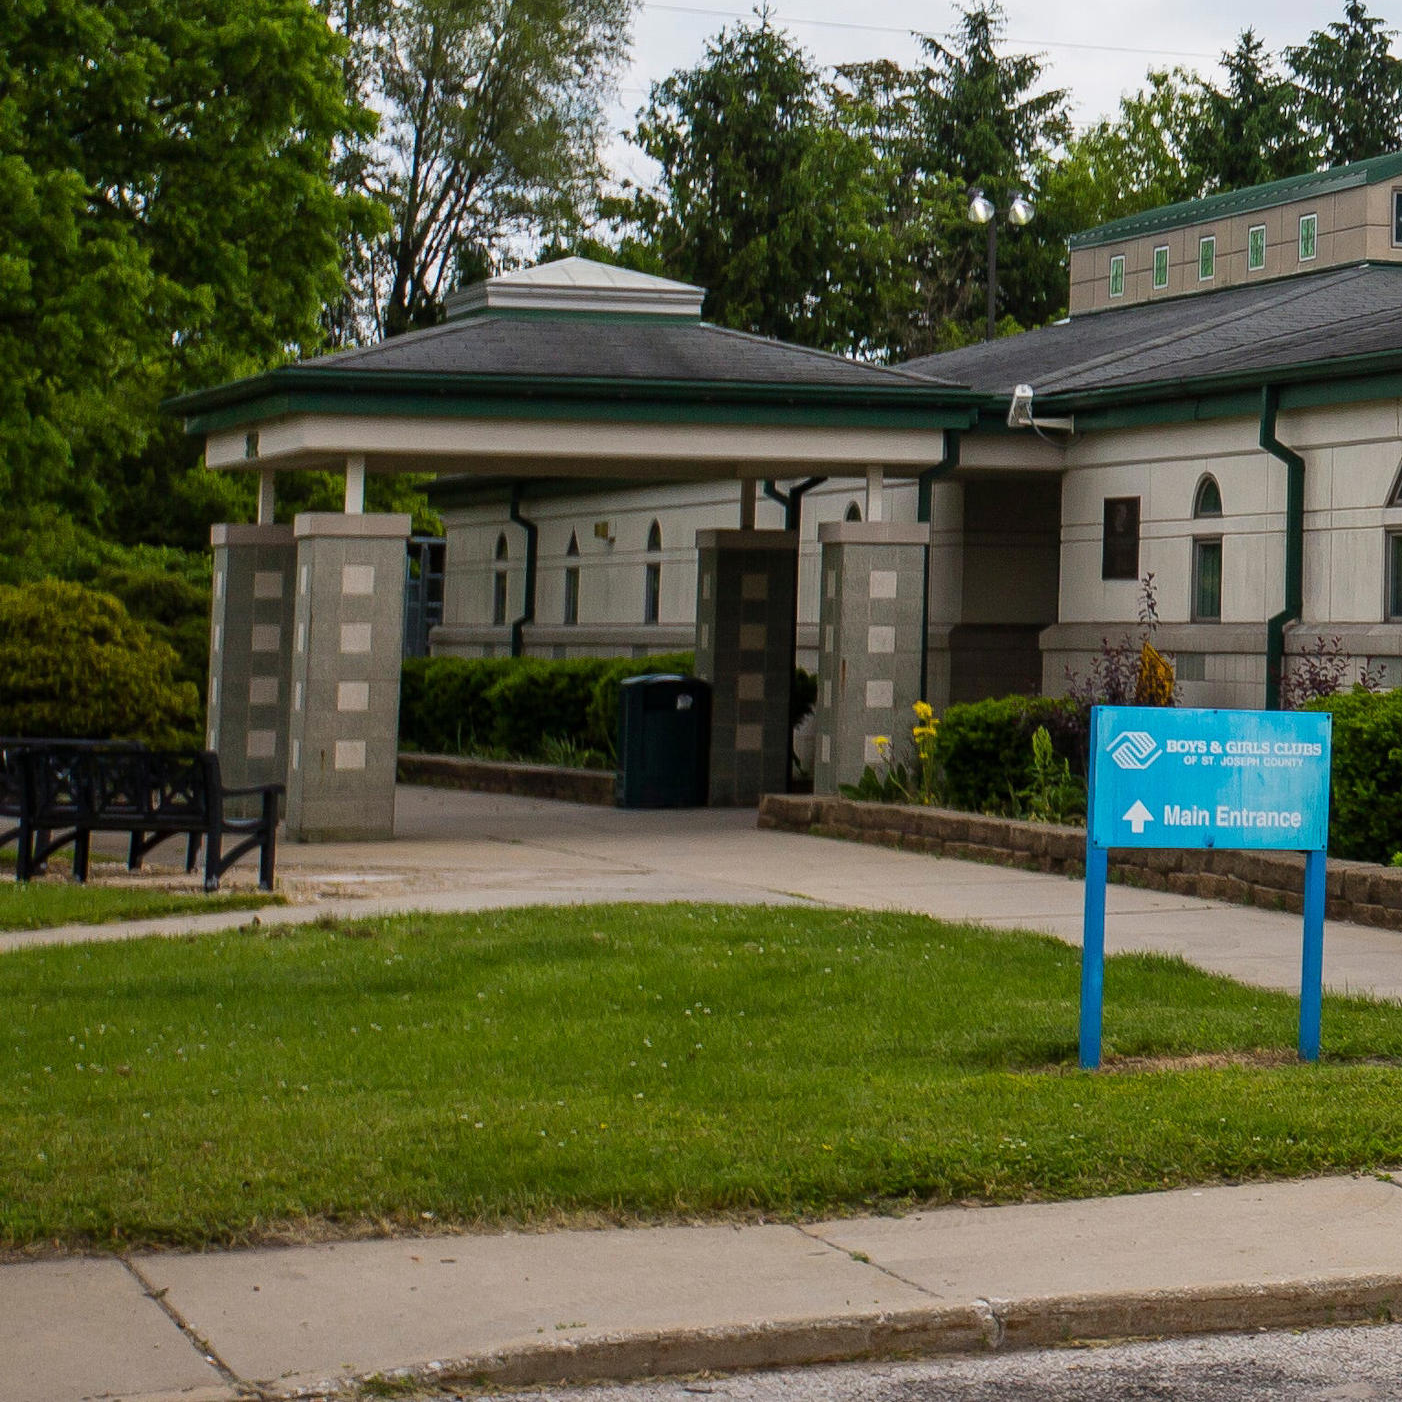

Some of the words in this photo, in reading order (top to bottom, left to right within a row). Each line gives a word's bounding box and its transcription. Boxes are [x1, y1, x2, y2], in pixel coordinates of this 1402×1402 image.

[1166, 739, 1207, 754] BOYS
[1209, 740, 1223, 755] &
[1225, 740, 1271, 755] GIRLS
[1274, 742, 1322, 756] CLUBS
[1183, 755, 1198, 766] OF
[1201, 756, 1217, 766] ST.
[1220, 756, 1260, 767] JOSEPH
[1263, 757, 1304, 767] COUNTY
[1163, 804, 1210, 827] Main
[1216, 805, 1302, 828] Entrance
